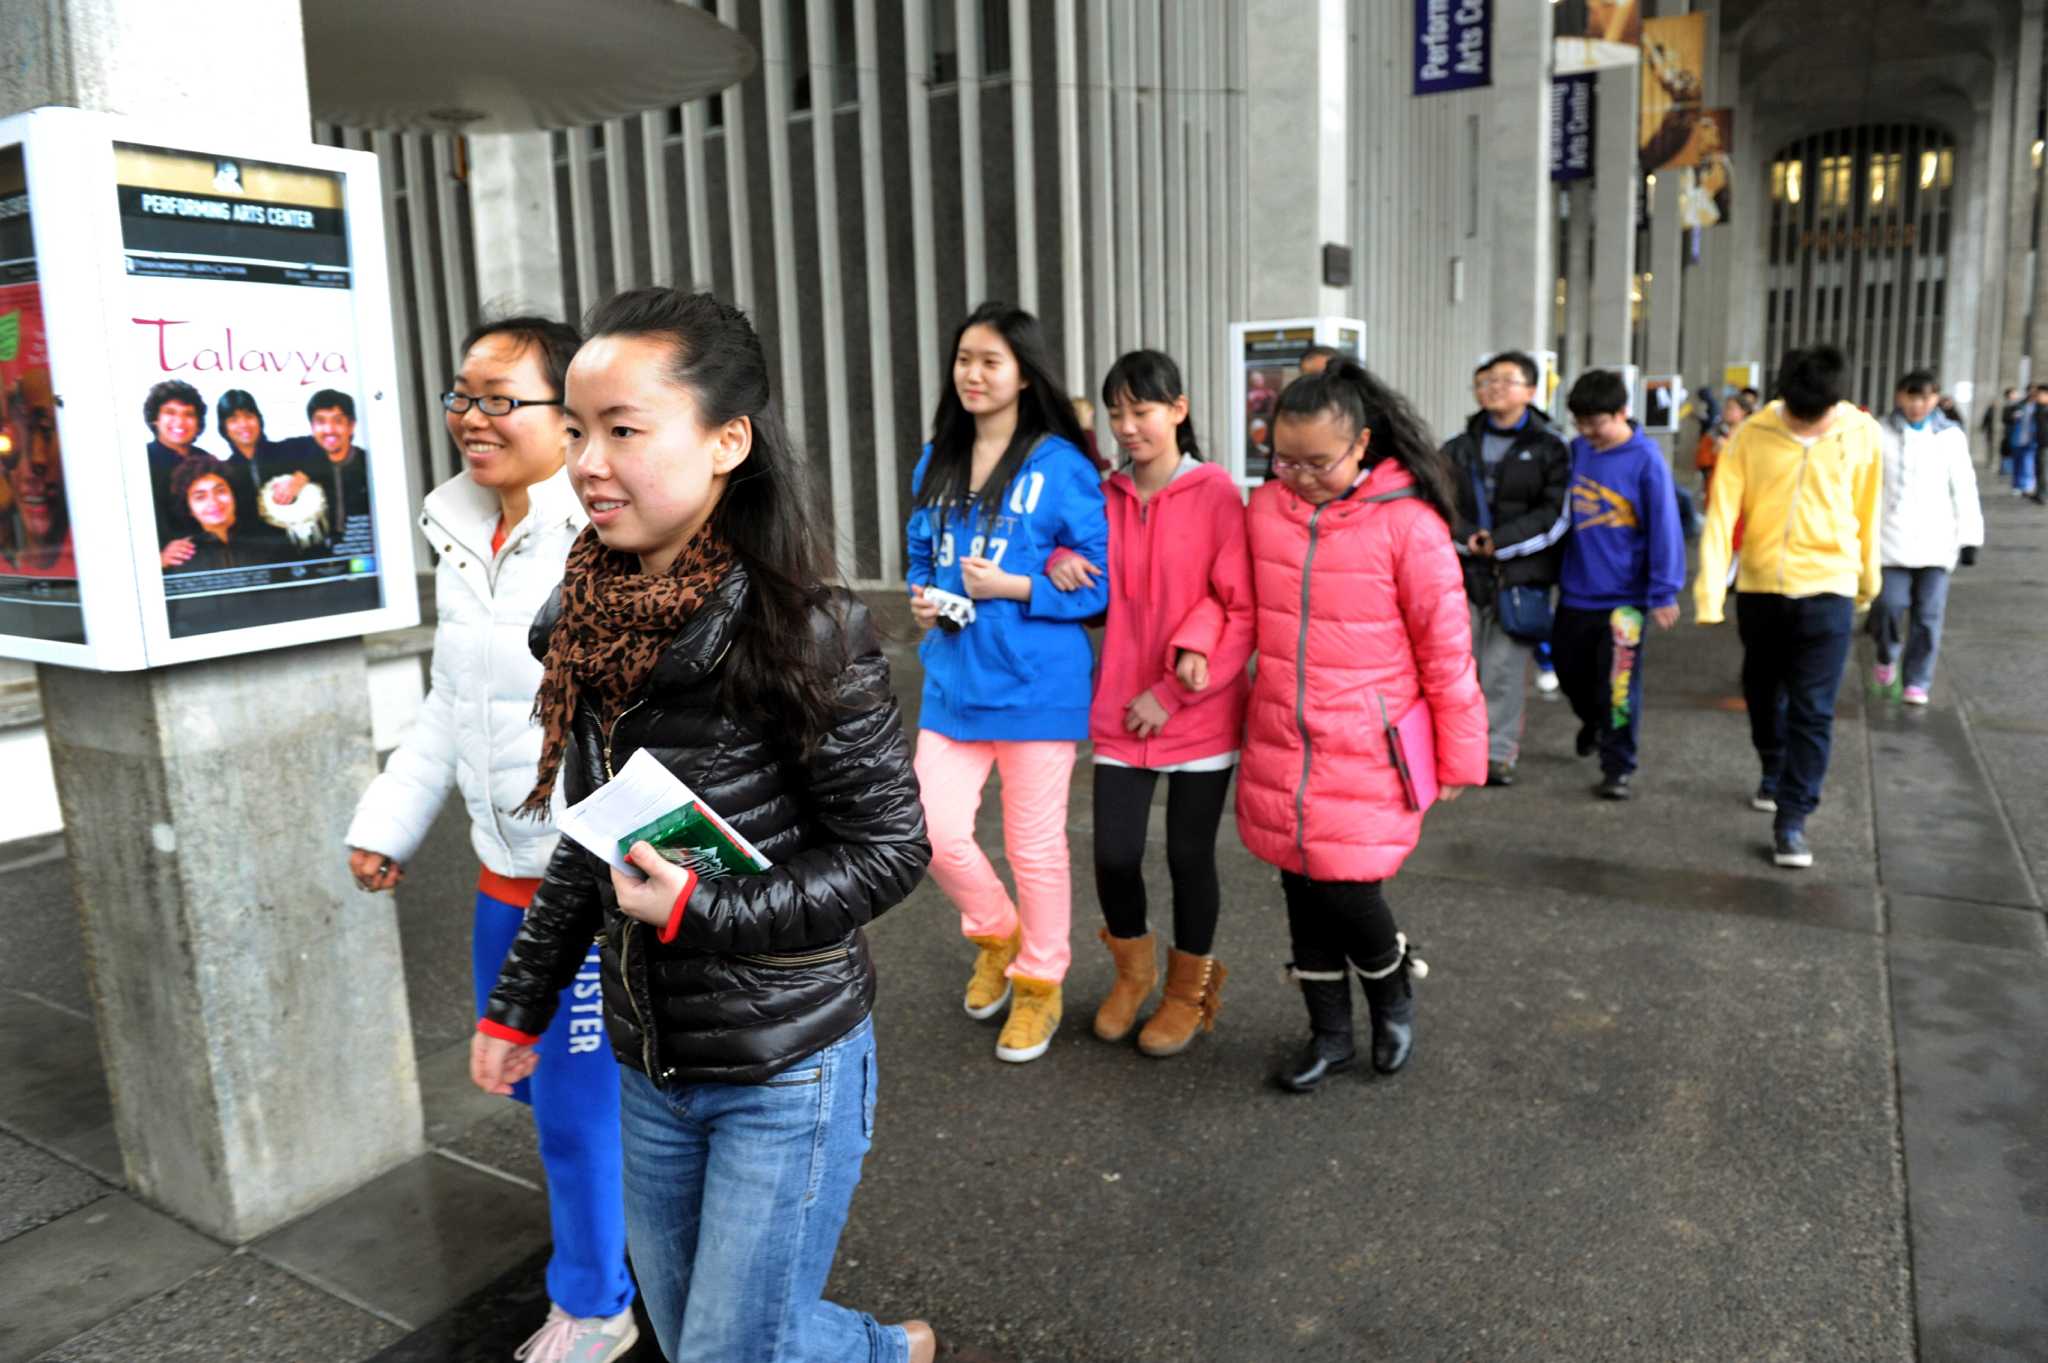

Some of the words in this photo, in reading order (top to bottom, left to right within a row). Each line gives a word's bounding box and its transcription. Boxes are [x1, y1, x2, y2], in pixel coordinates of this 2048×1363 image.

[1455, 27, 1483, 74] Arts
[1566, 81, 1589, 134] Center
[141, 193, 231, 220] PERFORMING
[232, 203, 266, 225] ARTS
[266, 207, 316, 229] CENTER
[131, 318, 348, 386] Talavya
